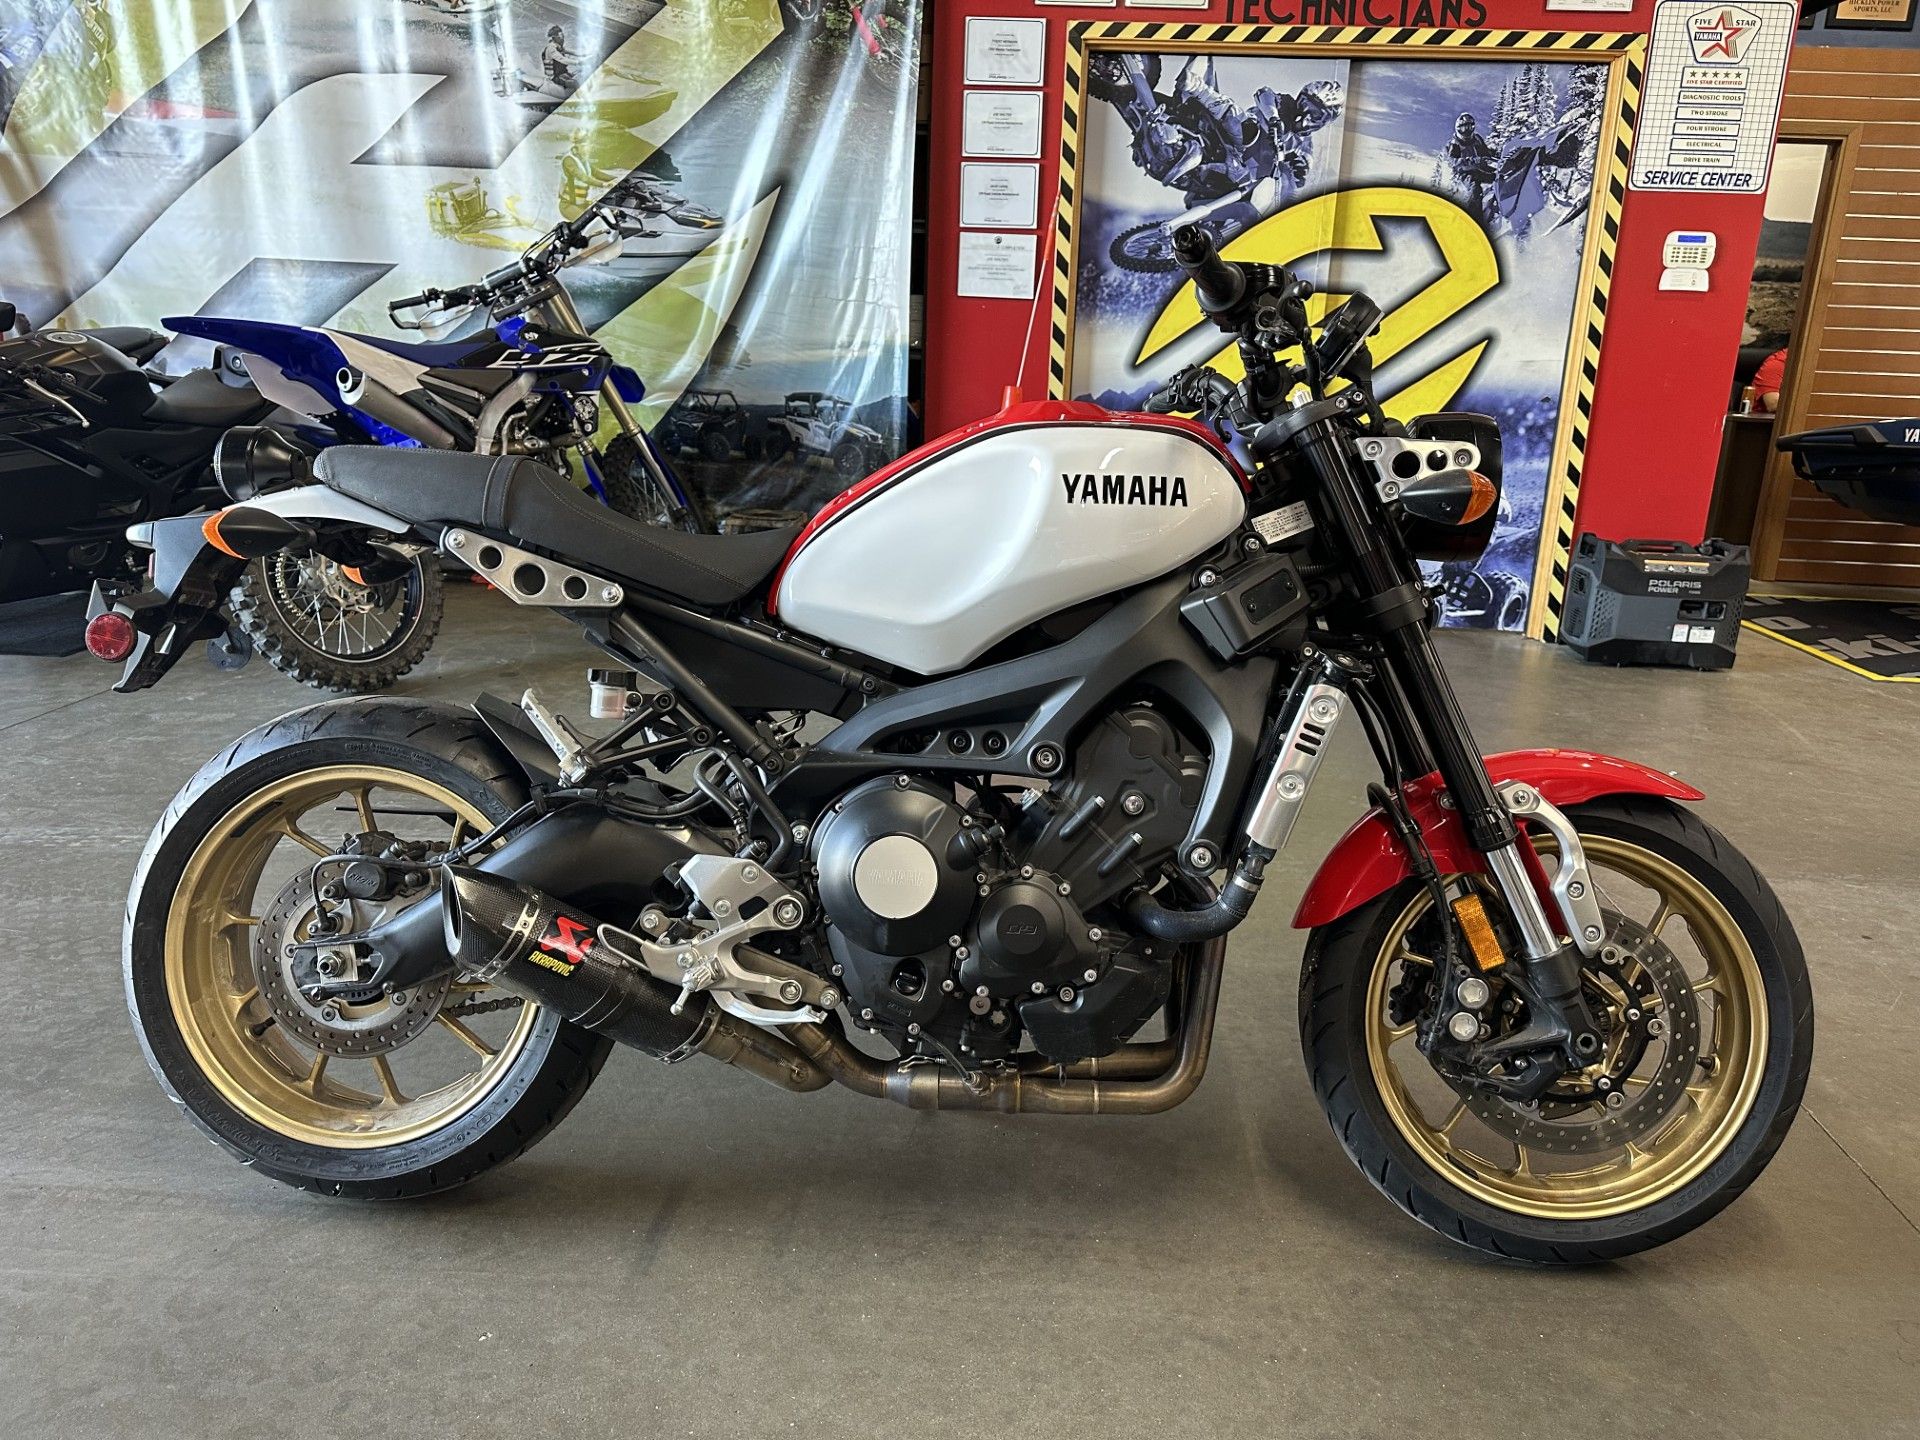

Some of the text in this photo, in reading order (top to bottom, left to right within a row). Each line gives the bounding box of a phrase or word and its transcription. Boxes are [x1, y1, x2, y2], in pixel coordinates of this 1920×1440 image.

[1695, 32, 1721, 40] YAMAHA
[1642, 170, 1752, 187] SERVICE CENTER
[1904, 428, 1920, 442] YA
[1061, 473, 1188, 507] YAMAHA
[1648, 579, 1702, 589] POLARIS
[1648, 586, 1679, 594] POWER
